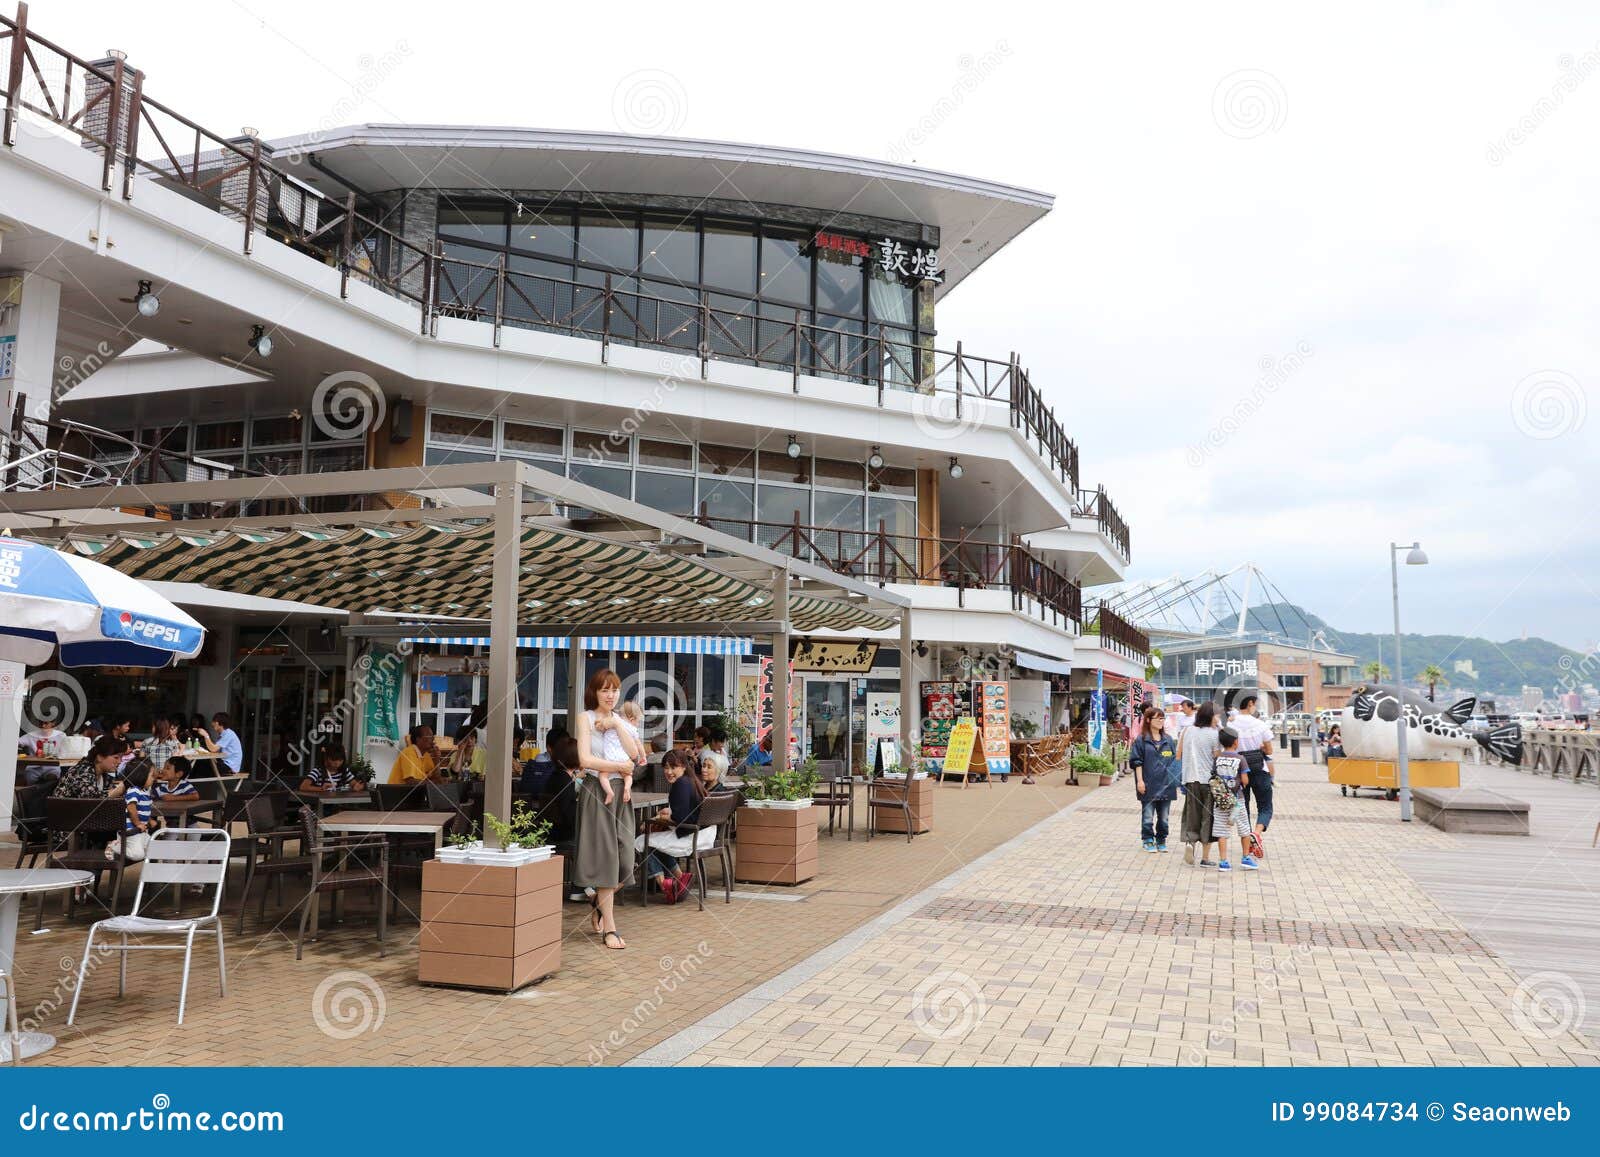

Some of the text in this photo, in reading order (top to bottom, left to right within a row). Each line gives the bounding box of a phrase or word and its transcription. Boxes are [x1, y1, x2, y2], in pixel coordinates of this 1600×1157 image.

[876, 238, 943, 283] 敦煌
[133, 619, 181, 643] PEPSI
[1195, 658, 1257, 676] 唐戸市場
